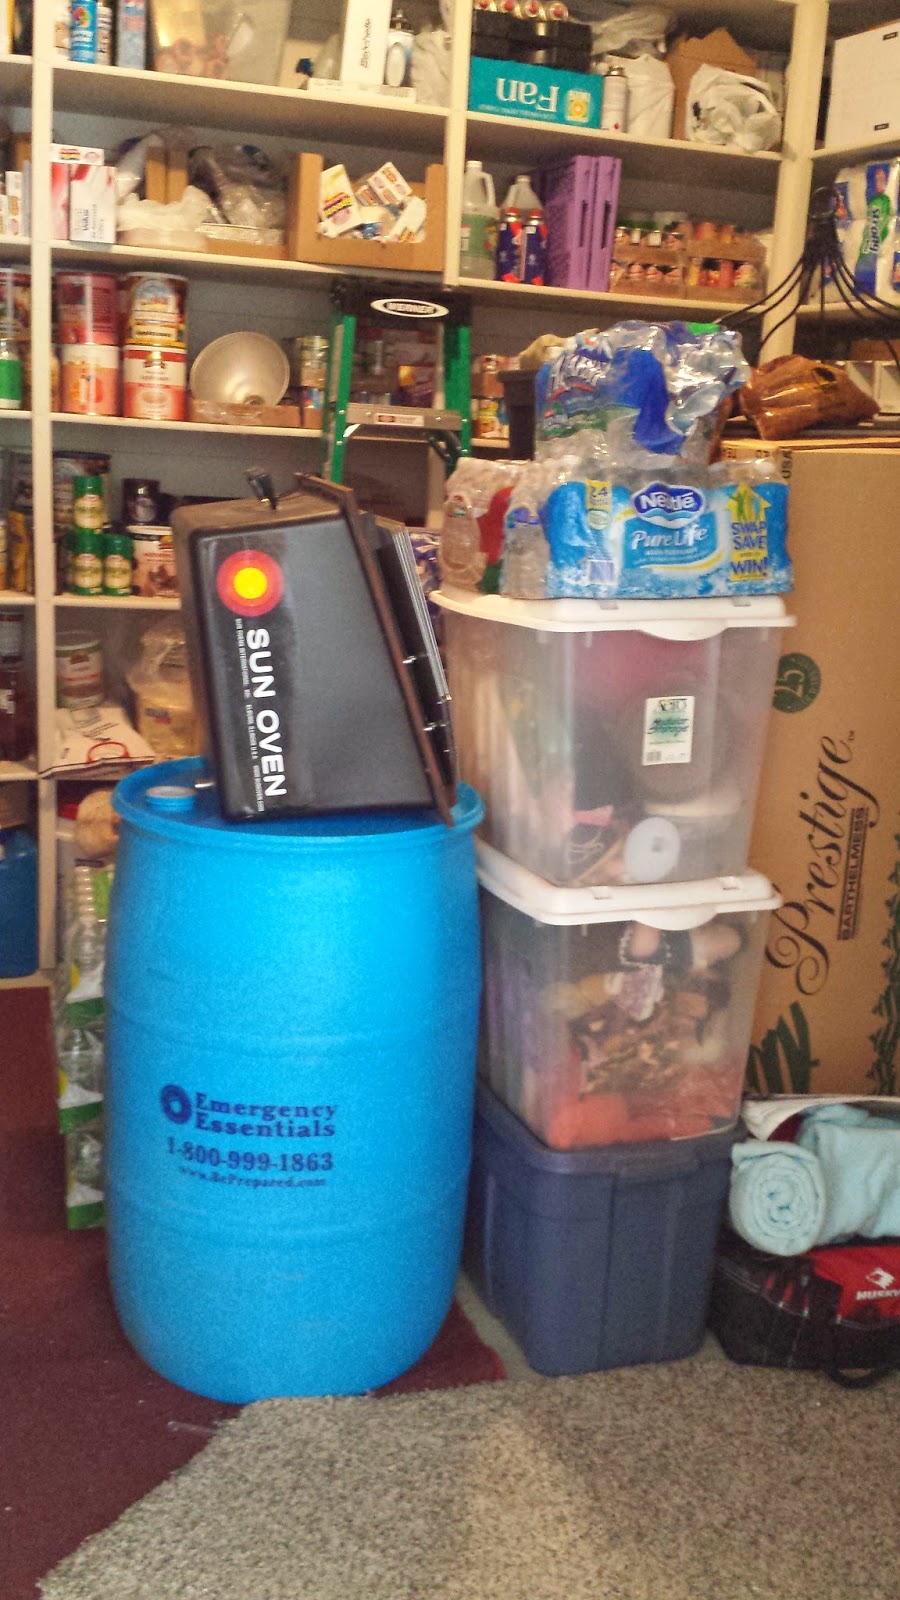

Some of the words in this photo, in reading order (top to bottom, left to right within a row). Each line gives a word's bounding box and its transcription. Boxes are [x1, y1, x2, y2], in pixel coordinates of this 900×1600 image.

[496, 78, 559, 112] Fan
[631, 530, 673, 550] Pure
[733, 536, 766, 550] SAVE
[246, 628, 276, 698] SUN
[256, 709, 288, 797] OVEN
[764, 735, 881, 996] Prestige
[195, 1092, 336, 1121] Emergency
[195, 1111, 336, 1138] Essentials
[167, 1136, 334, 1172] 1-800-999-1863
